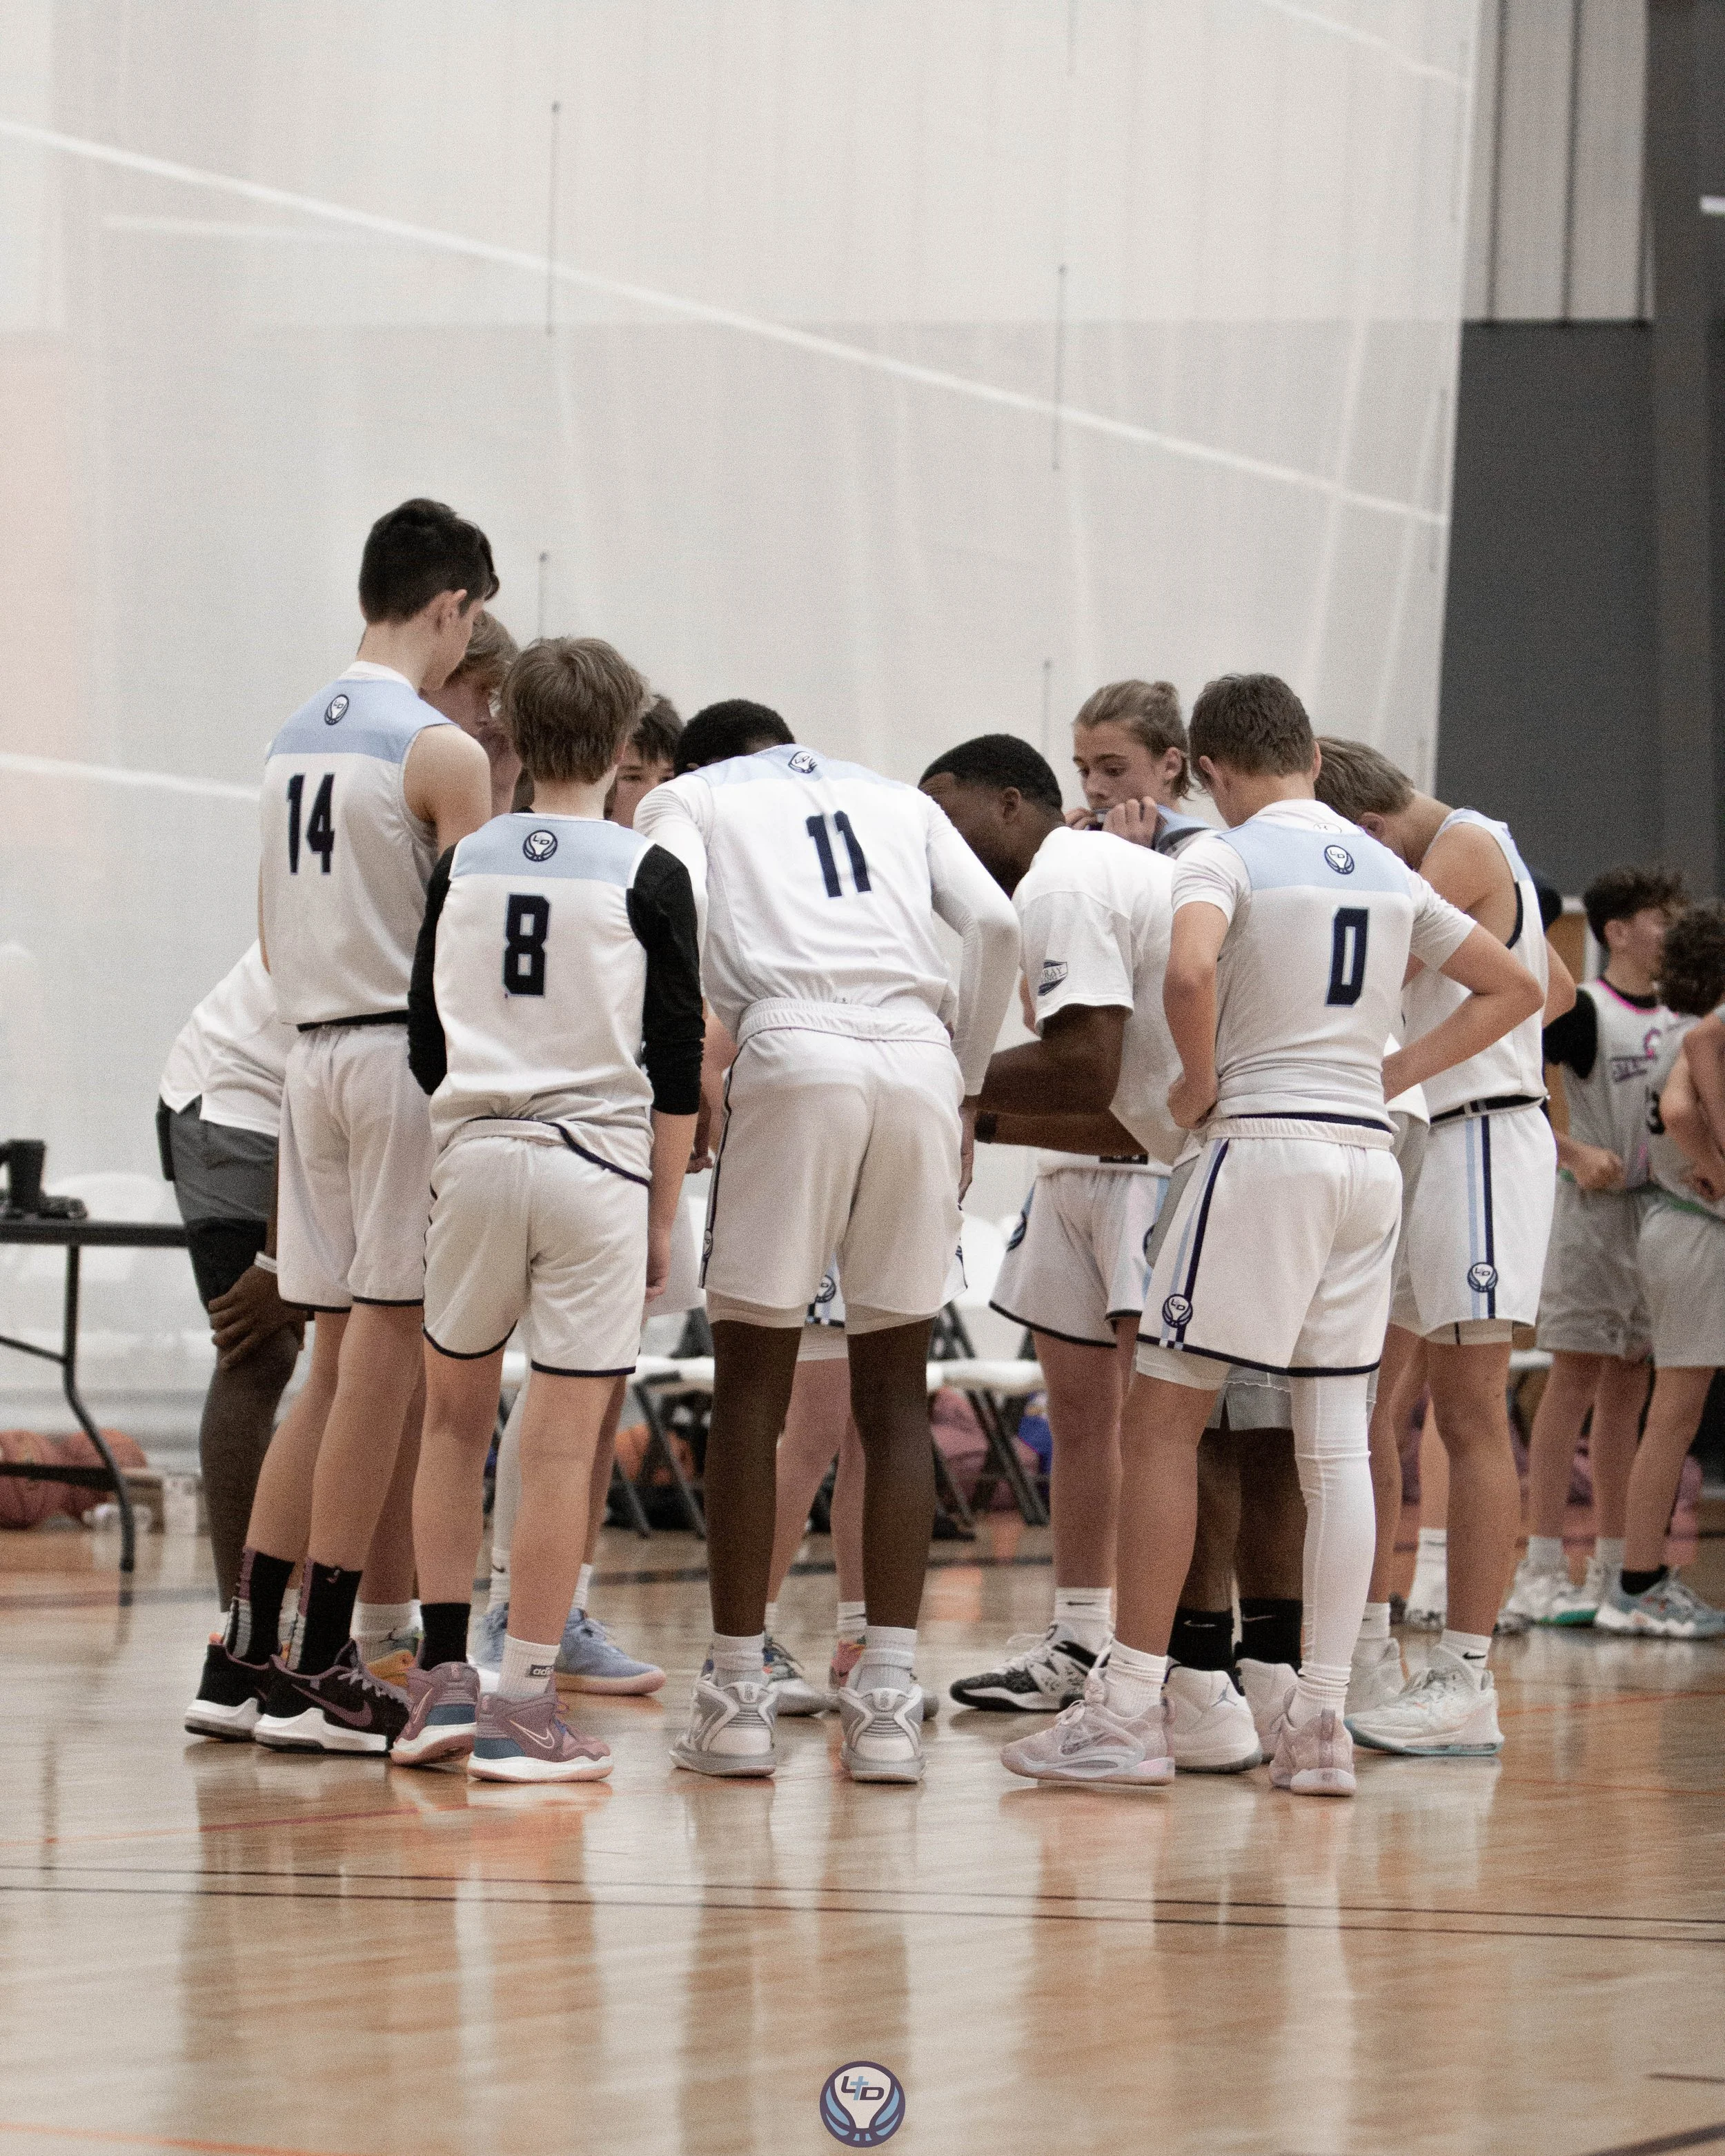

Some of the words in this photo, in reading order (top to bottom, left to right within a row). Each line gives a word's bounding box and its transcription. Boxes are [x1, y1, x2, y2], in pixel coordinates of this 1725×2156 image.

[286, 773, 336, 876] 14
[804, 810, 873, 899] 11
[502, 891, 551, 998] 8
[1325, 905, 1370, 1008] 0
